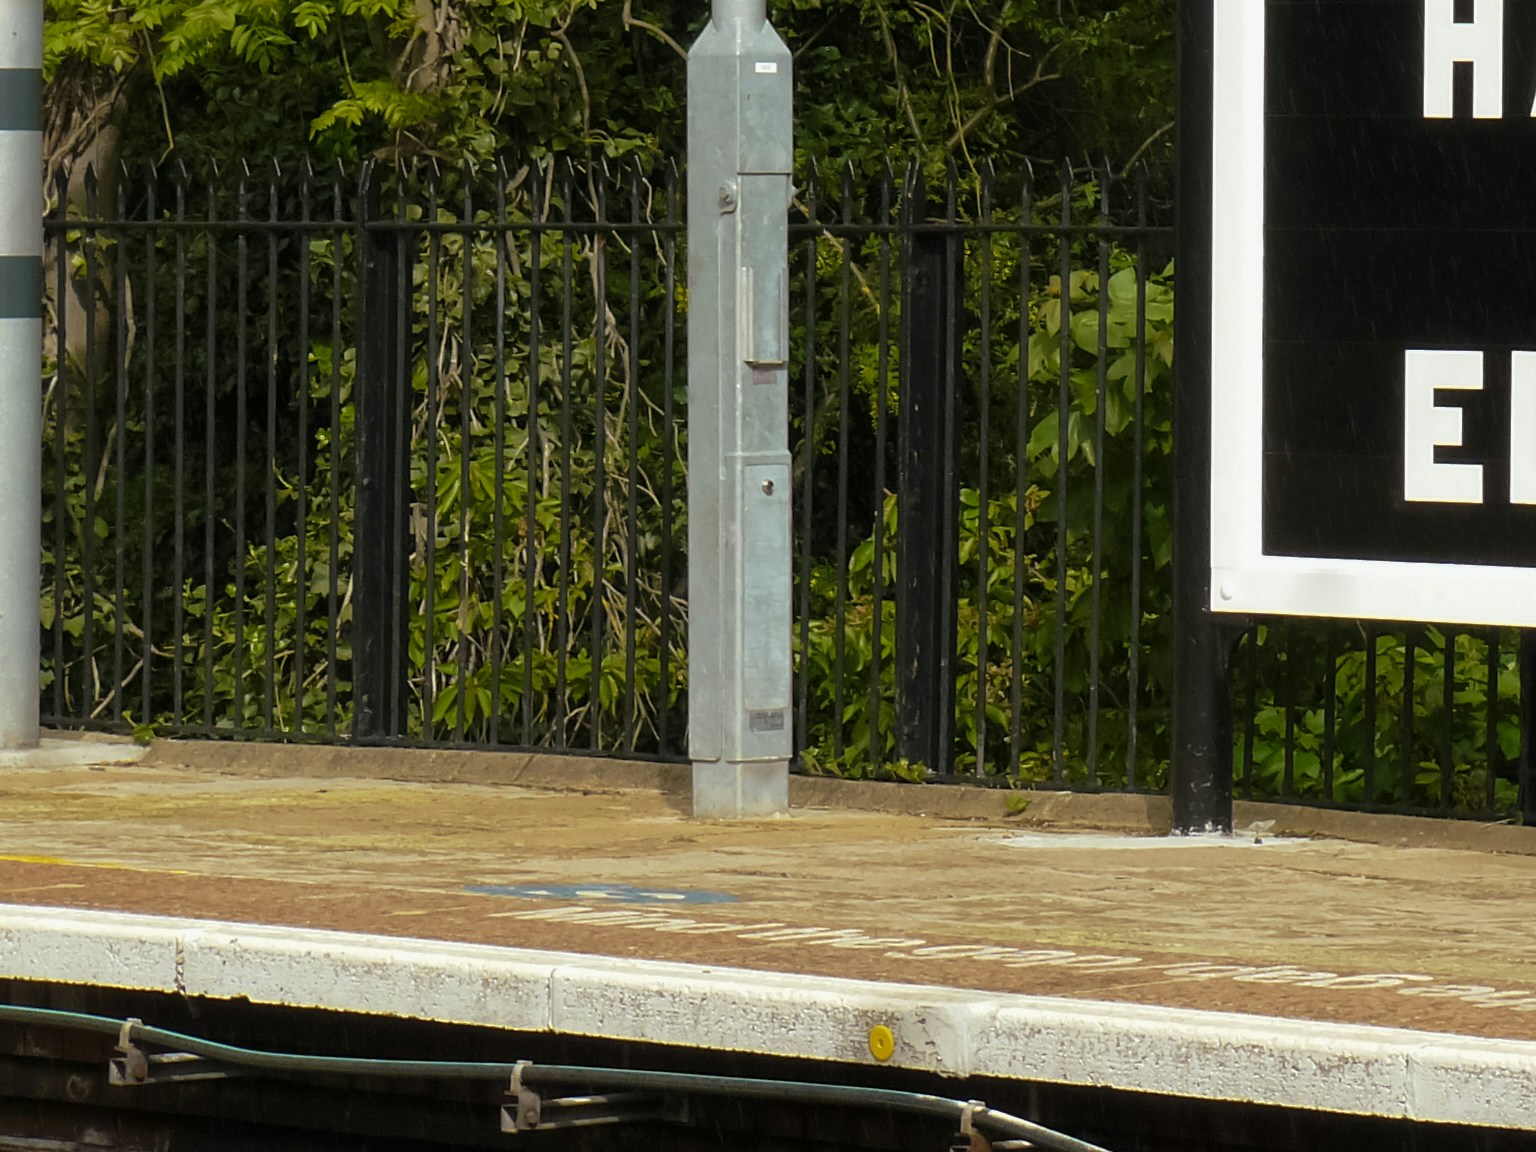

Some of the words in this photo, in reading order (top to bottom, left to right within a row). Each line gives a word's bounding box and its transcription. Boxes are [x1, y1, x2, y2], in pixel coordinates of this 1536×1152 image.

[487, 905, 786, 935] Mind
[736, 927, 927, 949] the
[884, 944, 1144, 969] gap
[1163, 964, 1434, 990] gap
